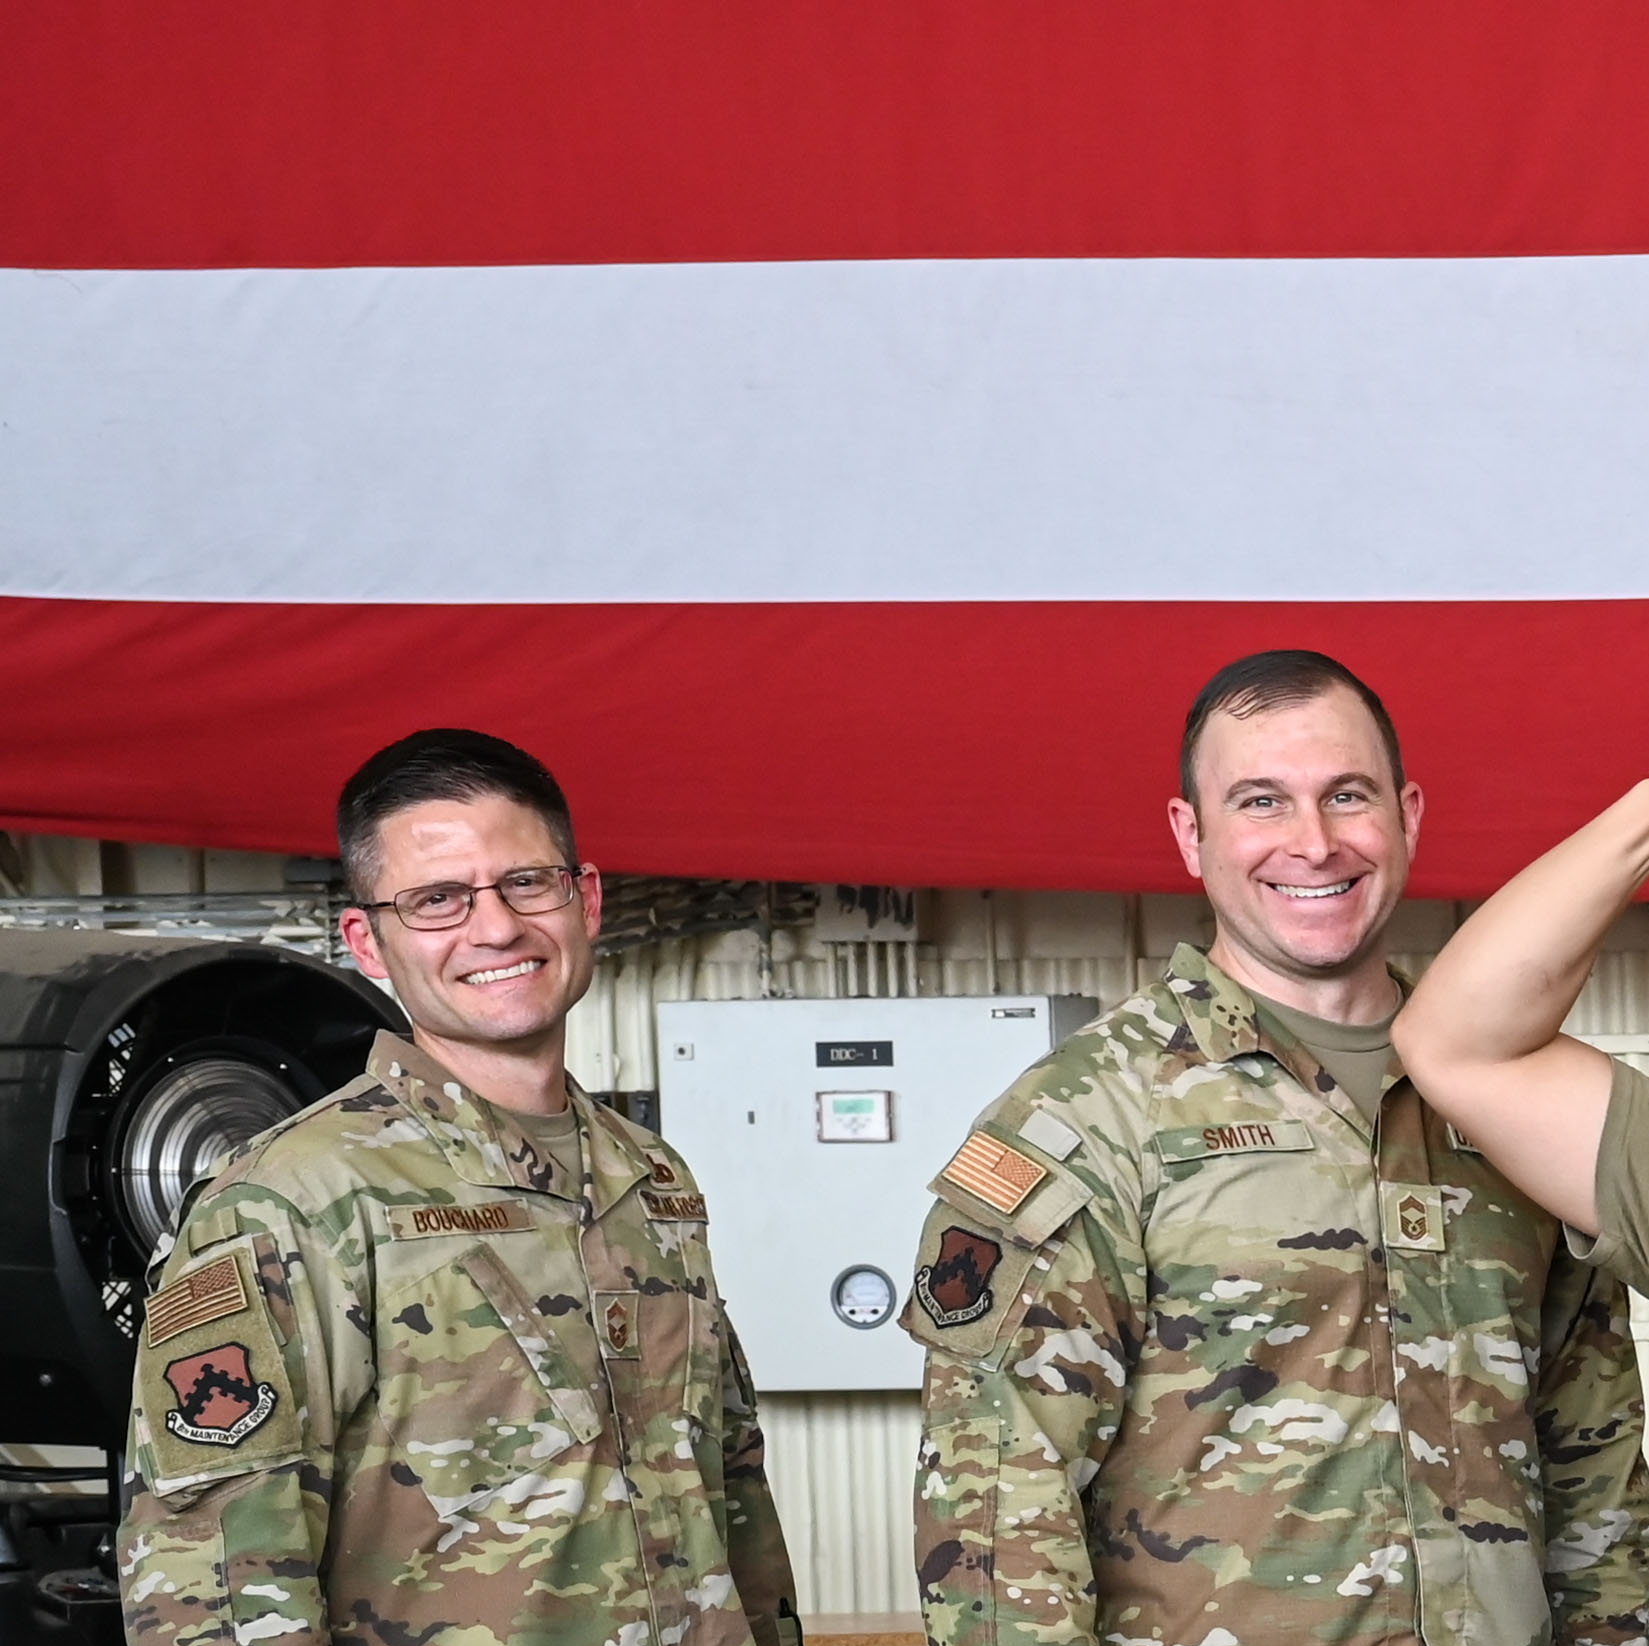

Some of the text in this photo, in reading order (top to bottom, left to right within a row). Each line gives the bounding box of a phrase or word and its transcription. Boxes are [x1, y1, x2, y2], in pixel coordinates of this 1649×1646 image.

[1202, 1124, 1277, 1150] SMITH
[412, 1207, 509, 1234] BOUCHARD
[190, 1421, 250, 1442] MAINTENANCE
